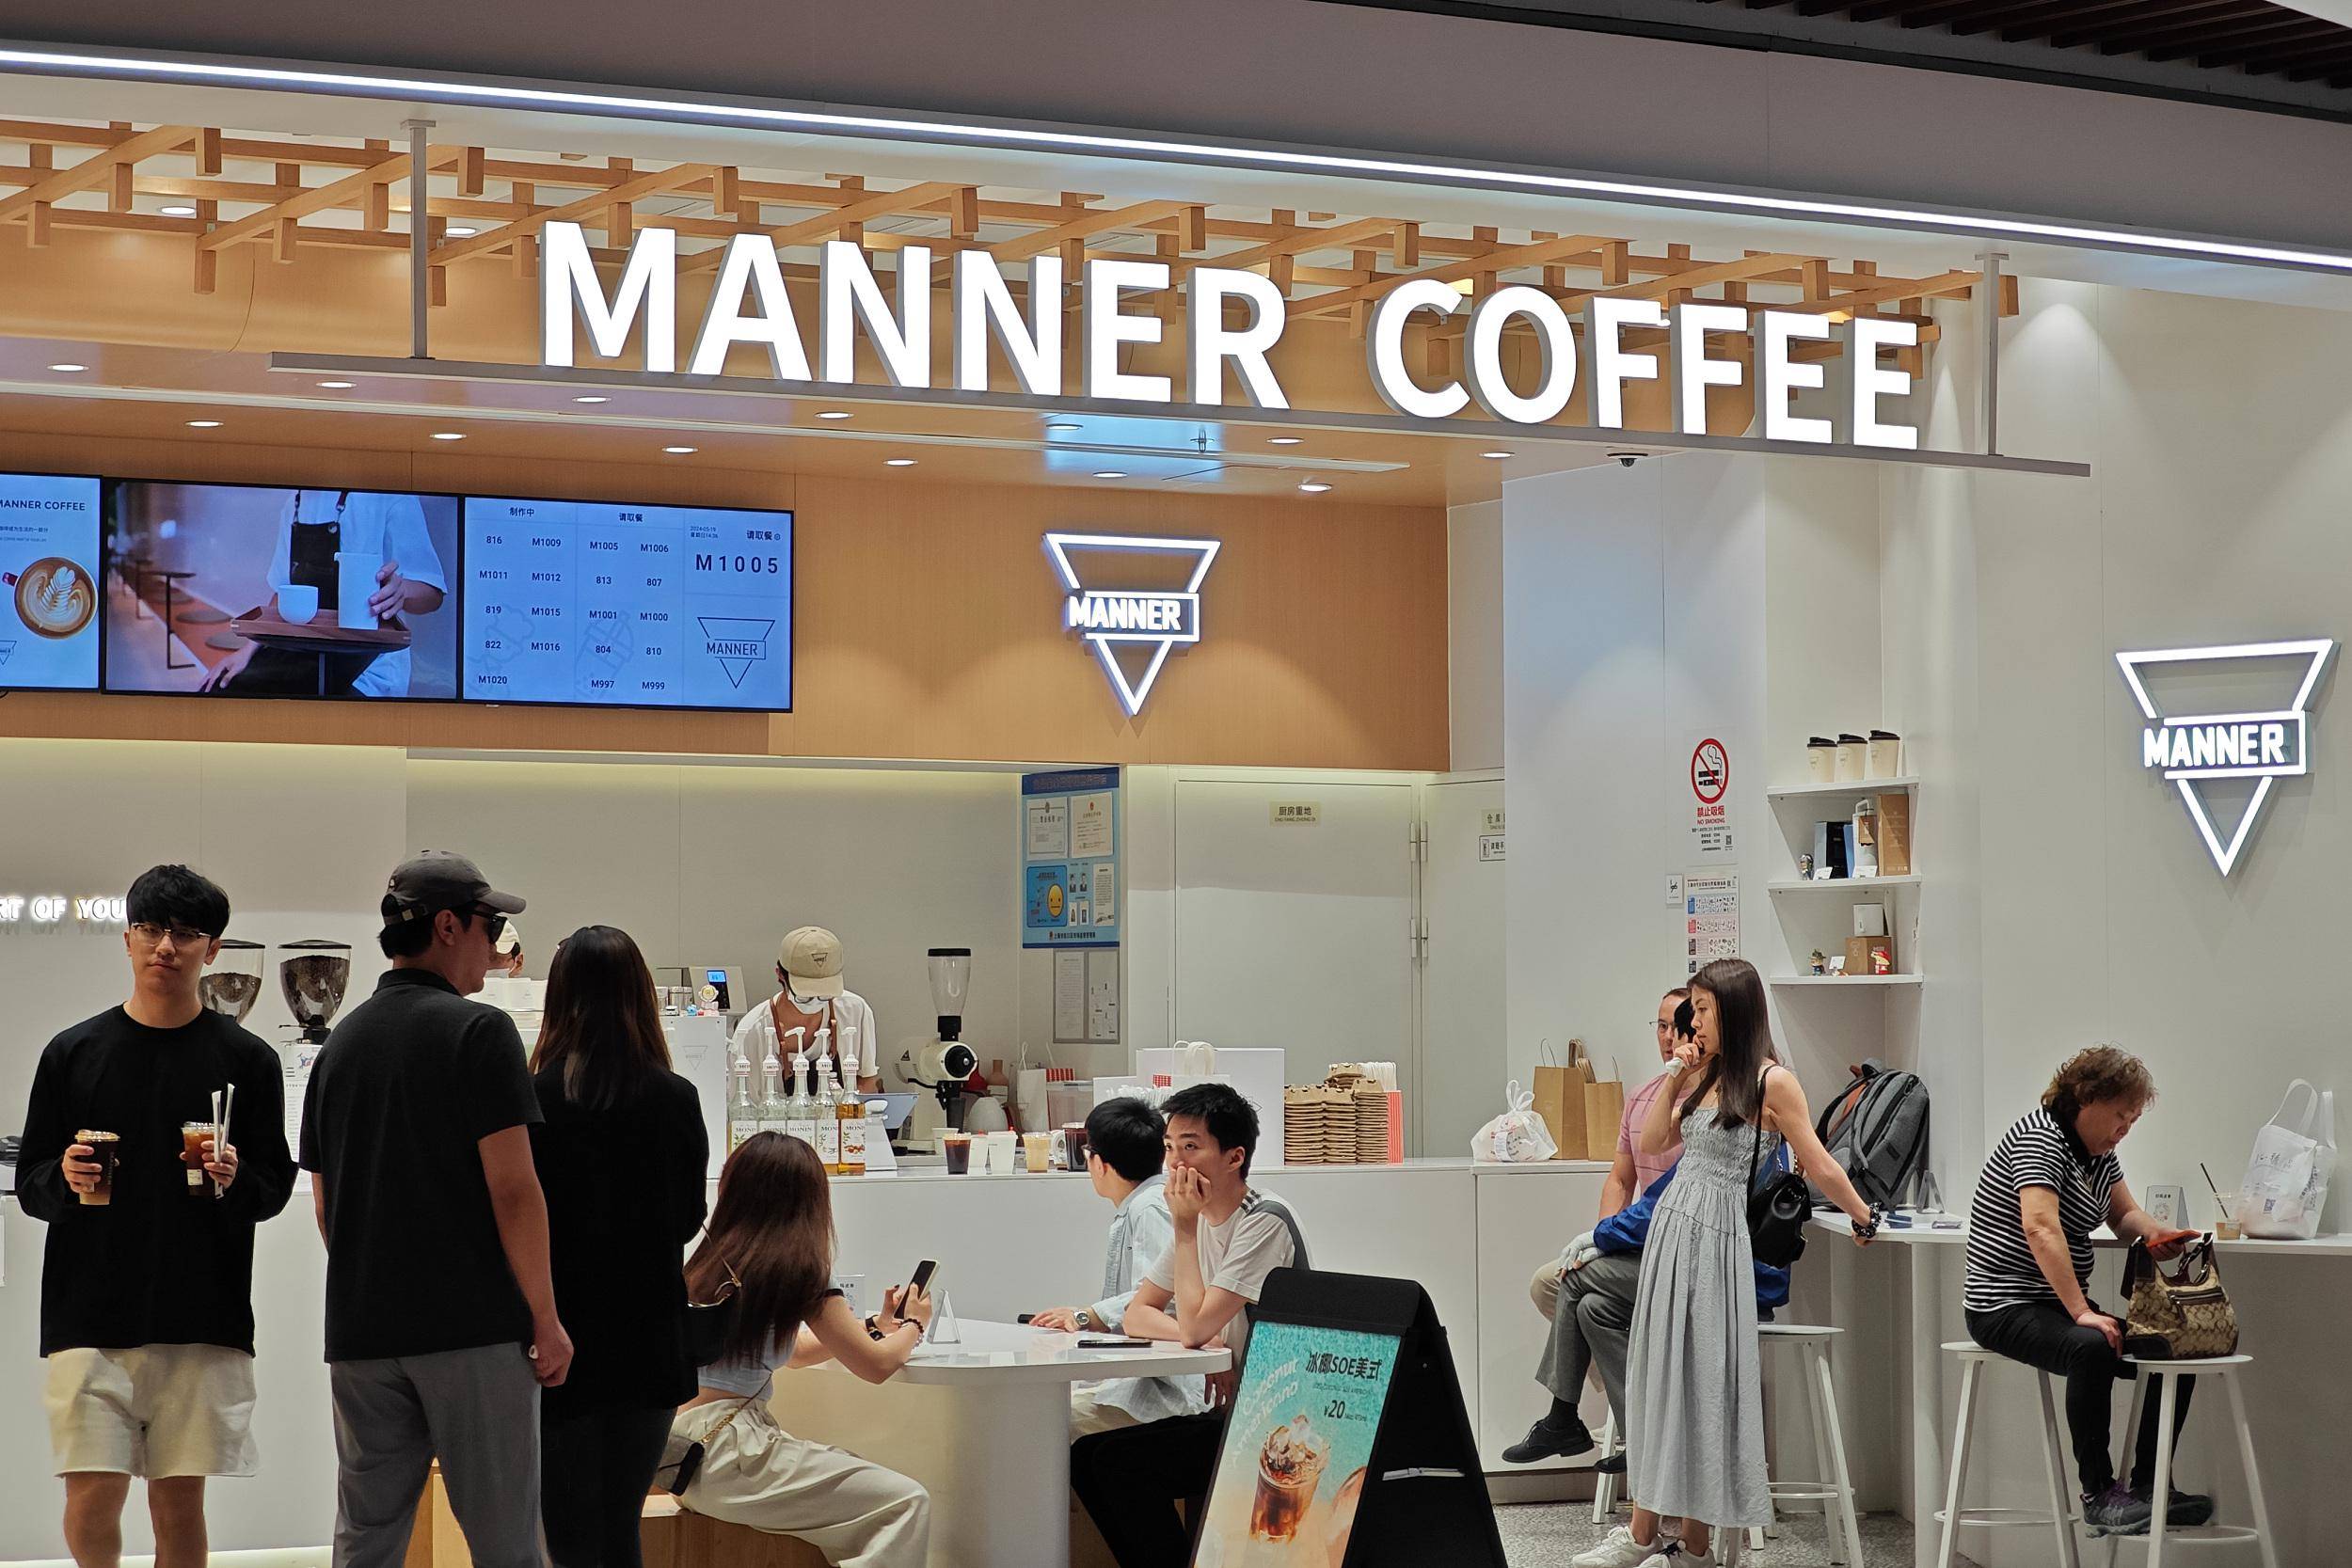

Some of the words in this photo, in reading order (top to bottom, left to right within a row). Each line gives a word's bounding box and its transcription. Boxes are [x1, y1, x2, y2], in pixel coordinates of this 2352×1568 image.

[540, 220, 1291, 410] MANNER
[1367, 278, 1918, 451] COFFEE
[44, 501, 86, 511] COFFEE
[509, 507, 534, 517] 制作中
[618, 512, 644, 523] 请取餐
[485, 535, 502, 545] 816
[746, 531, 772, 540] 请取餐
[532, 538, 562, 547] M1009
[589, 541, 619, 551] M1005
[640, 543, 670, 553] M1006
[479, 570, 508, 579] M1011
[532, 572, 562, 582] M1012
[596, 576, 612, 585] 813
[646, 578, 662, 587] 807
[485, 605, 501, 615] 819
[531, 607, 561, 617] M1015
[589, 610, 618, 620] M1001
[1066, 595, 1182, 631] MANNER
[640, 611, 669, 622] M1000
[485, 640, 501, 650] 822
[531, 641, 561, 652] M1016
[595, 644, 612, 655] 804
[707, 641, 758, 656] MANNER
[645, 646, 662, 657] 810
[478, 674, 508, 685] M1020
[591, 679, 614, 689] M997
[642, 681, 665, 691] M999
[2143, 723, 2286, 768] MANNER
[1697, 805, 1724, 817] 禁止吸烟
[32, 896, 67, 920] OF
[1306, 1352, 1382, 1381] 冰椰SOE美式
[1324, 1400, 1345, 1418] ¥20
